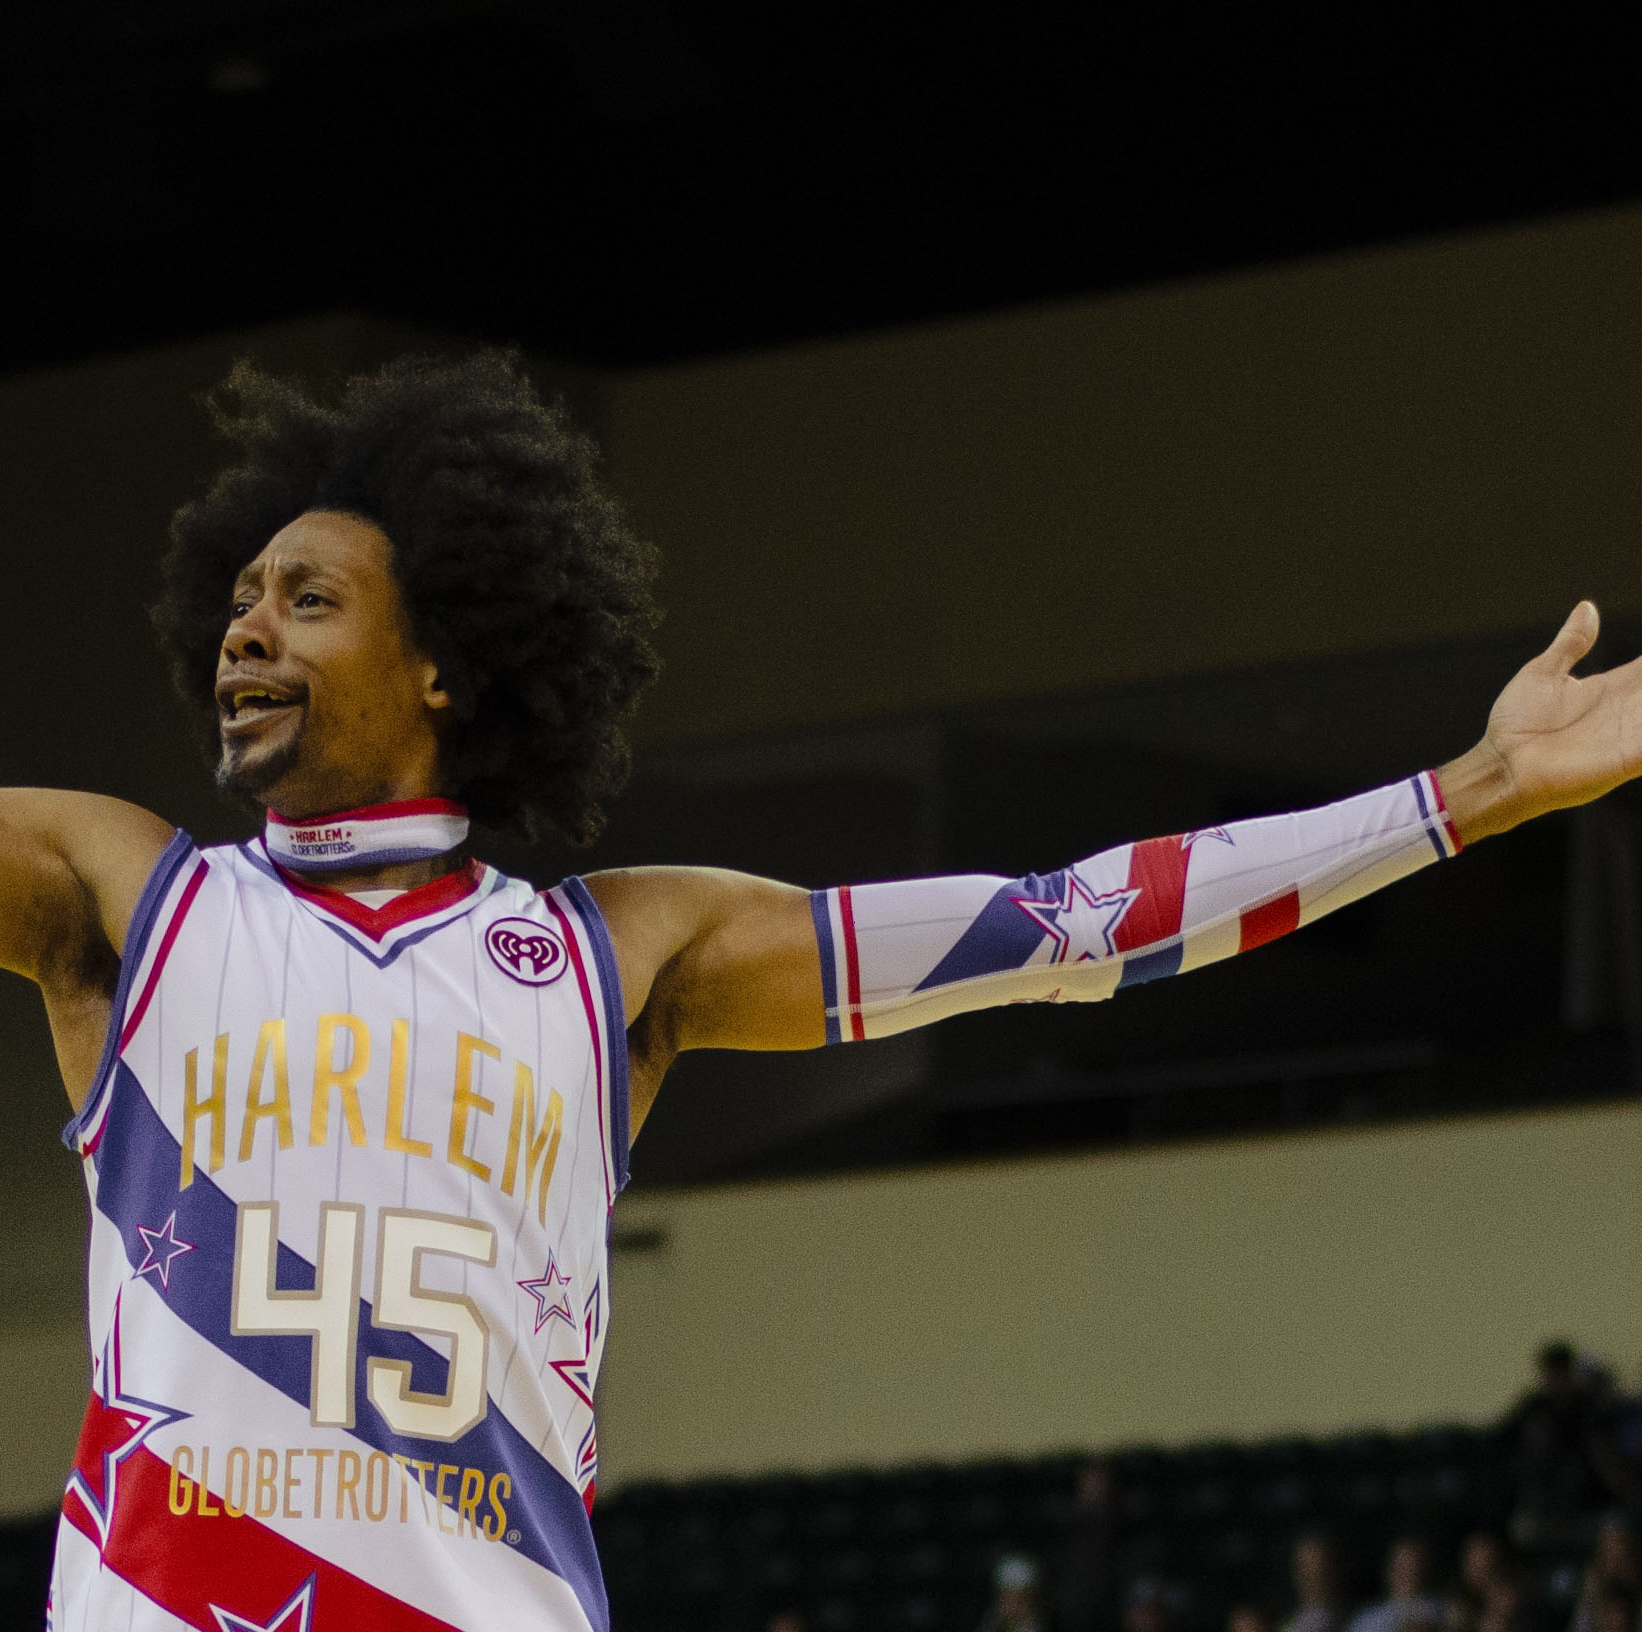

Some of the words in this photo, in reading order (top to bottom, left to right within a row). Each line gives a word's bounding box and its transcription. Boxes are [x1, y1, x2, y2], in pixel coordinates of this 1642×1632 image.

[295, 828, 343, 843] HARLEM
[180, 1012, 564, 1231] HARLEM
[230, 1200, 497, 1444] 45
[168, 1445, 512, 1544] GLOBETROTTERS
